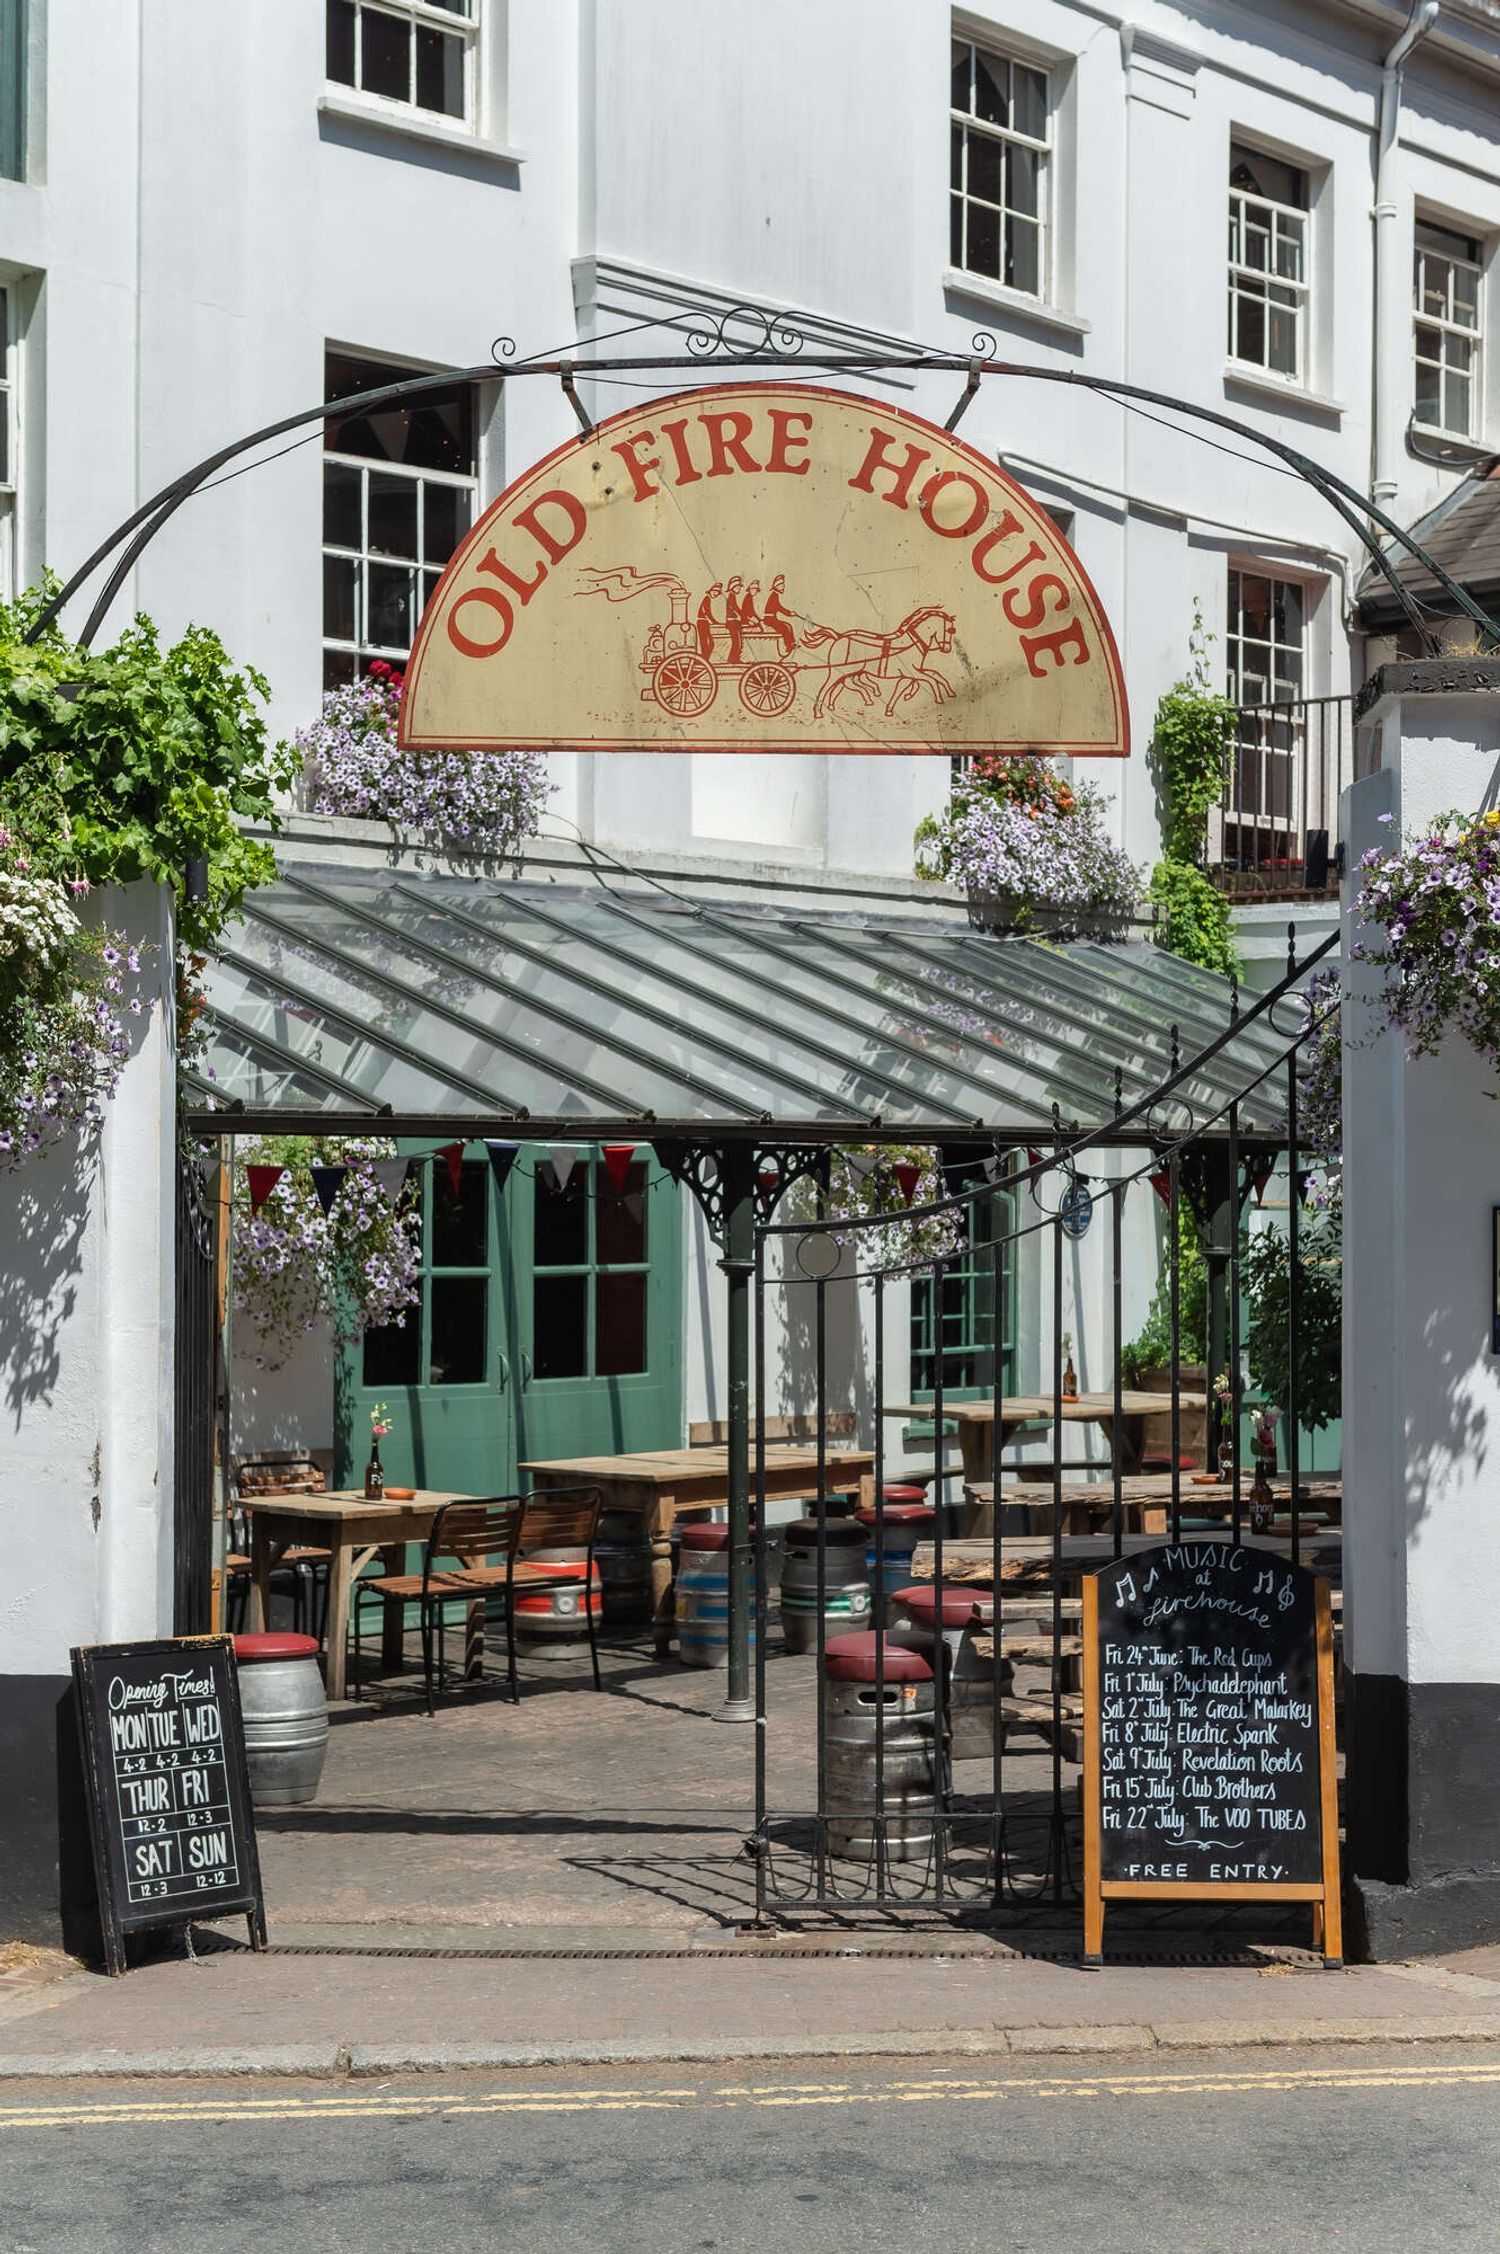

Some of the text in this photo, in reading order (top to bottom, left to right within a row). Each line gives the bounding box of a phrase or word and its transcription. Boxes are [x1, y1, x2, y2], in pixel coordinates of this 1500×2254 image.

[446, 409, 1091, 678] OLD FIRE HOUSE
[1165, 1544, 1244, 1571] MUSIC
[1195, 1569, 1211, 1586] at
[1143, 1591, 1272, 1628] firehouse
[1105, 1644, 1124, 1665] Fri
[1187, 1646, 1211, 1666] The
[1213, 1646, 1236, 1667] Red
[1241, 1648, 1273, 1674] Cups
[108, 1676, 169, 1709] Opening
[1104, 1672, 1121, 1693] Fri
[1173, 1671, 1288, 1703] Psychadelephant
[1101, 1697, 1125, 1720] Sat
[1177, 1698, 1198, 1718] The
[1205, 1697, 1248, 1720] Great
[111, 1704, 220, 1752] MON TUE WED
[1102, 1722, 1121, 1743] Fri
[1177, 1721, 1228, 1743] Electric
[1102, 1747, 1126, 1771] Sat
[1182, 1746, 1255, 1772] Revelation
[1261, 1747, 1303, 1774] Roots
[121, 1769, 210, 1815] THUR FRI
[1103, 1776, 1123, 1799] Fri
[1182, 1775, 1212, 1798] Club
[1214, 1775, 1276, 1800] Brothers
[1102, 1806, 1122, 1829] Fri
[1194, 1806, 1220, 1828] The
[1224, 1807, 1251, 1829] VOO
[1256, 1808, 1306, 1830] TUBES
[135, 1831, 227, 1877] SAT SUN
